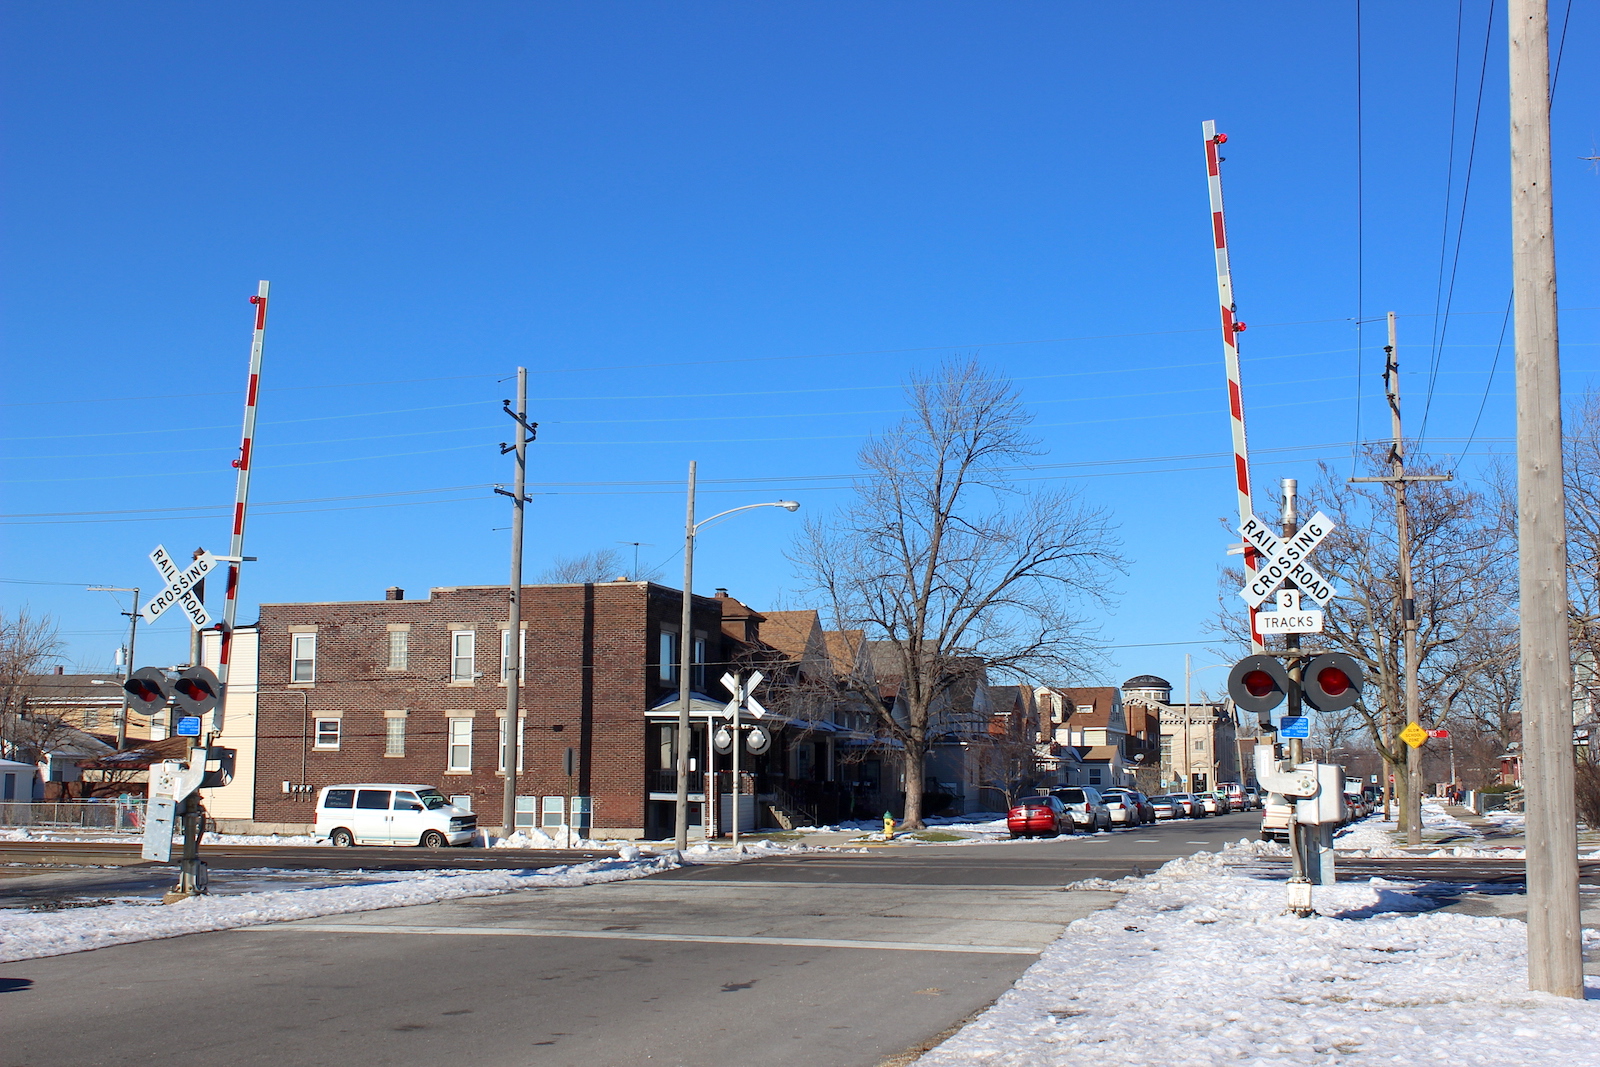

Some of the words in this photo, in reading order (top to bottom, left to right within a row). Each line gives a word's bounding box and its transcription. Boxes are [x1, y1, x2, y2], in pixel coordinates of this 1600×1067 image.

[1243, 520, 1277, 556] RAIL
[153, 549, 175, 582] RAIL
[1252, 524, 1323, 596] CROSSING
[150, 560, 208, 615] CROSSING
[1290, 564, 1329, 601] ROAD
[180, 590, 206, 625] ROAD
[1283, 593, 1293, 608] 3
[1264, 616, 1314, 628] TRACKS
